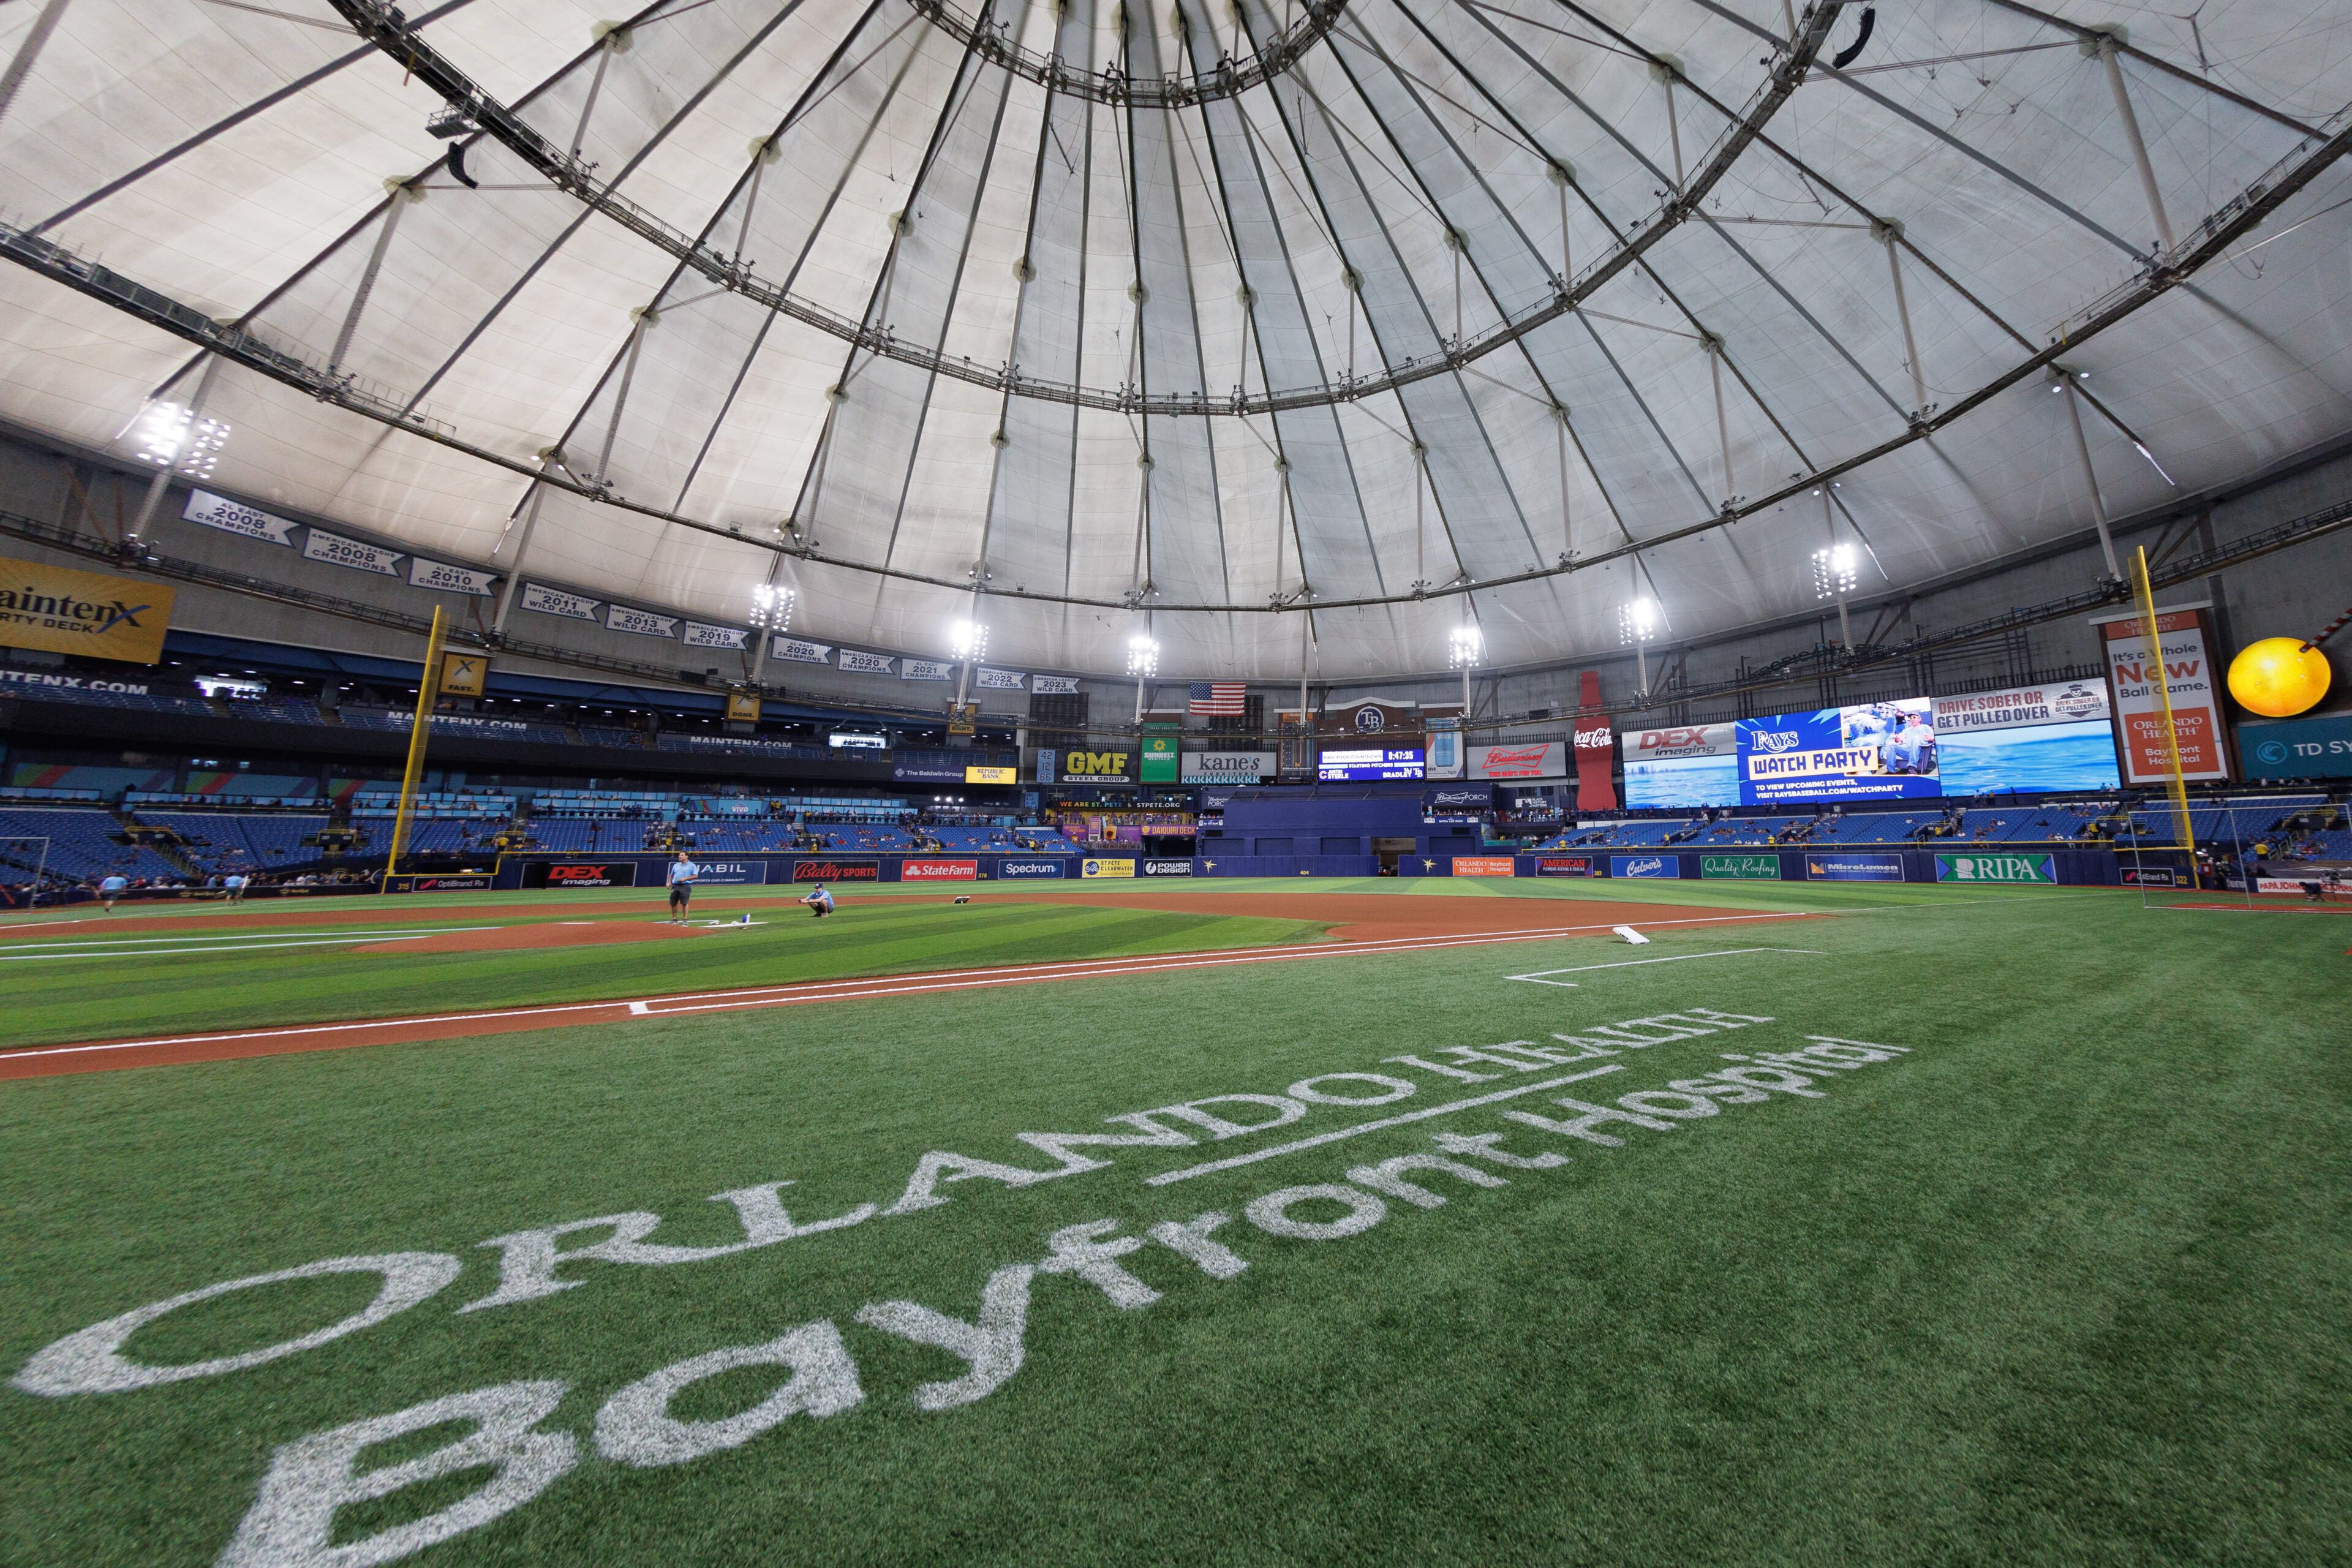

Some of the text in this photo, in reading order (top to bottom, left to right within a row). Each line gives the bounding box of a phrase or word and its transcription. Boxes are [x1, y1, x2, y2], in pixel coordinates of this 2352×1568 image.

[213, 507, 266, 529] 2008
[238, 508, 265, 519] EAST
[195, 512, 276, 540] CHAMPIONS
[311, 533, 396, 558] AMERICAN LEAGUE
[328, 543, 376, 562] 2008
[312, 549, 387, 572] CHAMPIONS
[431, 570, 472, 586] 2010
[449, 568, 470, 576] EAST
[418, 578, 481, 594] CHAMPIONS
[527, 587, 595, 605] AMERICAN LEAGUE
[543, 595, 578, 609] 2011
[529, 600, 587, 618] WILD CARD
[611, 608, 673, 623] AMERICAN LEAGUE
[42, 618, 94, 633] DECK
[613, 620, 666, 635] WILD CARD
[624, 615, 658, 628] 2013
[690, 636, 712, 644] WILD
[699, 630, 731, 641] 2019
[778, 651, 821, 662] CHAMPIONS
[786, 646, 815, 656] 2020
[2114, 652, 2134, 662] It's
[843, 663, 886, 673] CHAMPIONS
[851, 657, 880, 666] 2020
[913, 665, 937, 674] 2021
[2120, 686, 2149, 698] Ball
[1938, 690, 2044, 714] DRIVE SOBER OR
[1937, 706, 2049, 728] GET PULLED OVER
[1574, 727, 1613, 748] Coca-Cola
[1639, 727, 1709, 750] DEX
[1388, 751, 1414, 760] 0:47:35
[1655, 745, 1717, 756] imaging
[2293, 743, 2323, 756] TD
[1067, 752, 1128, 775] GMF
[1198, 753, 1261, 771] kane's
[1488, 752, 1542, 764] Budweiser
[1754, 750, 1872, 774] WATCH PARTY
[1042, 762, 1051, 771] 12
[1039, 773, 1051, 782] 66
[1774, 785, 1903, 798] RAYSBASEBALL.COM/WATCHPARTY
[549, 866, 608, 879] DEX
[795, 862, 876, 881] Bally SPORTS
[1006, 863, 1054, 875] Spectrum
[1627, 858, 1662, 876] Culver's
[1705, 858, 1775, 876] Quality Roofing
[1976, 859, 2039, 880] RIPA
[2176, 876, 2188, 884] 322
[9, 1008, 1775, 1398] ORLANDO HEALTH
[214, 1035, 1912, 1568] Bayfront Hospital
